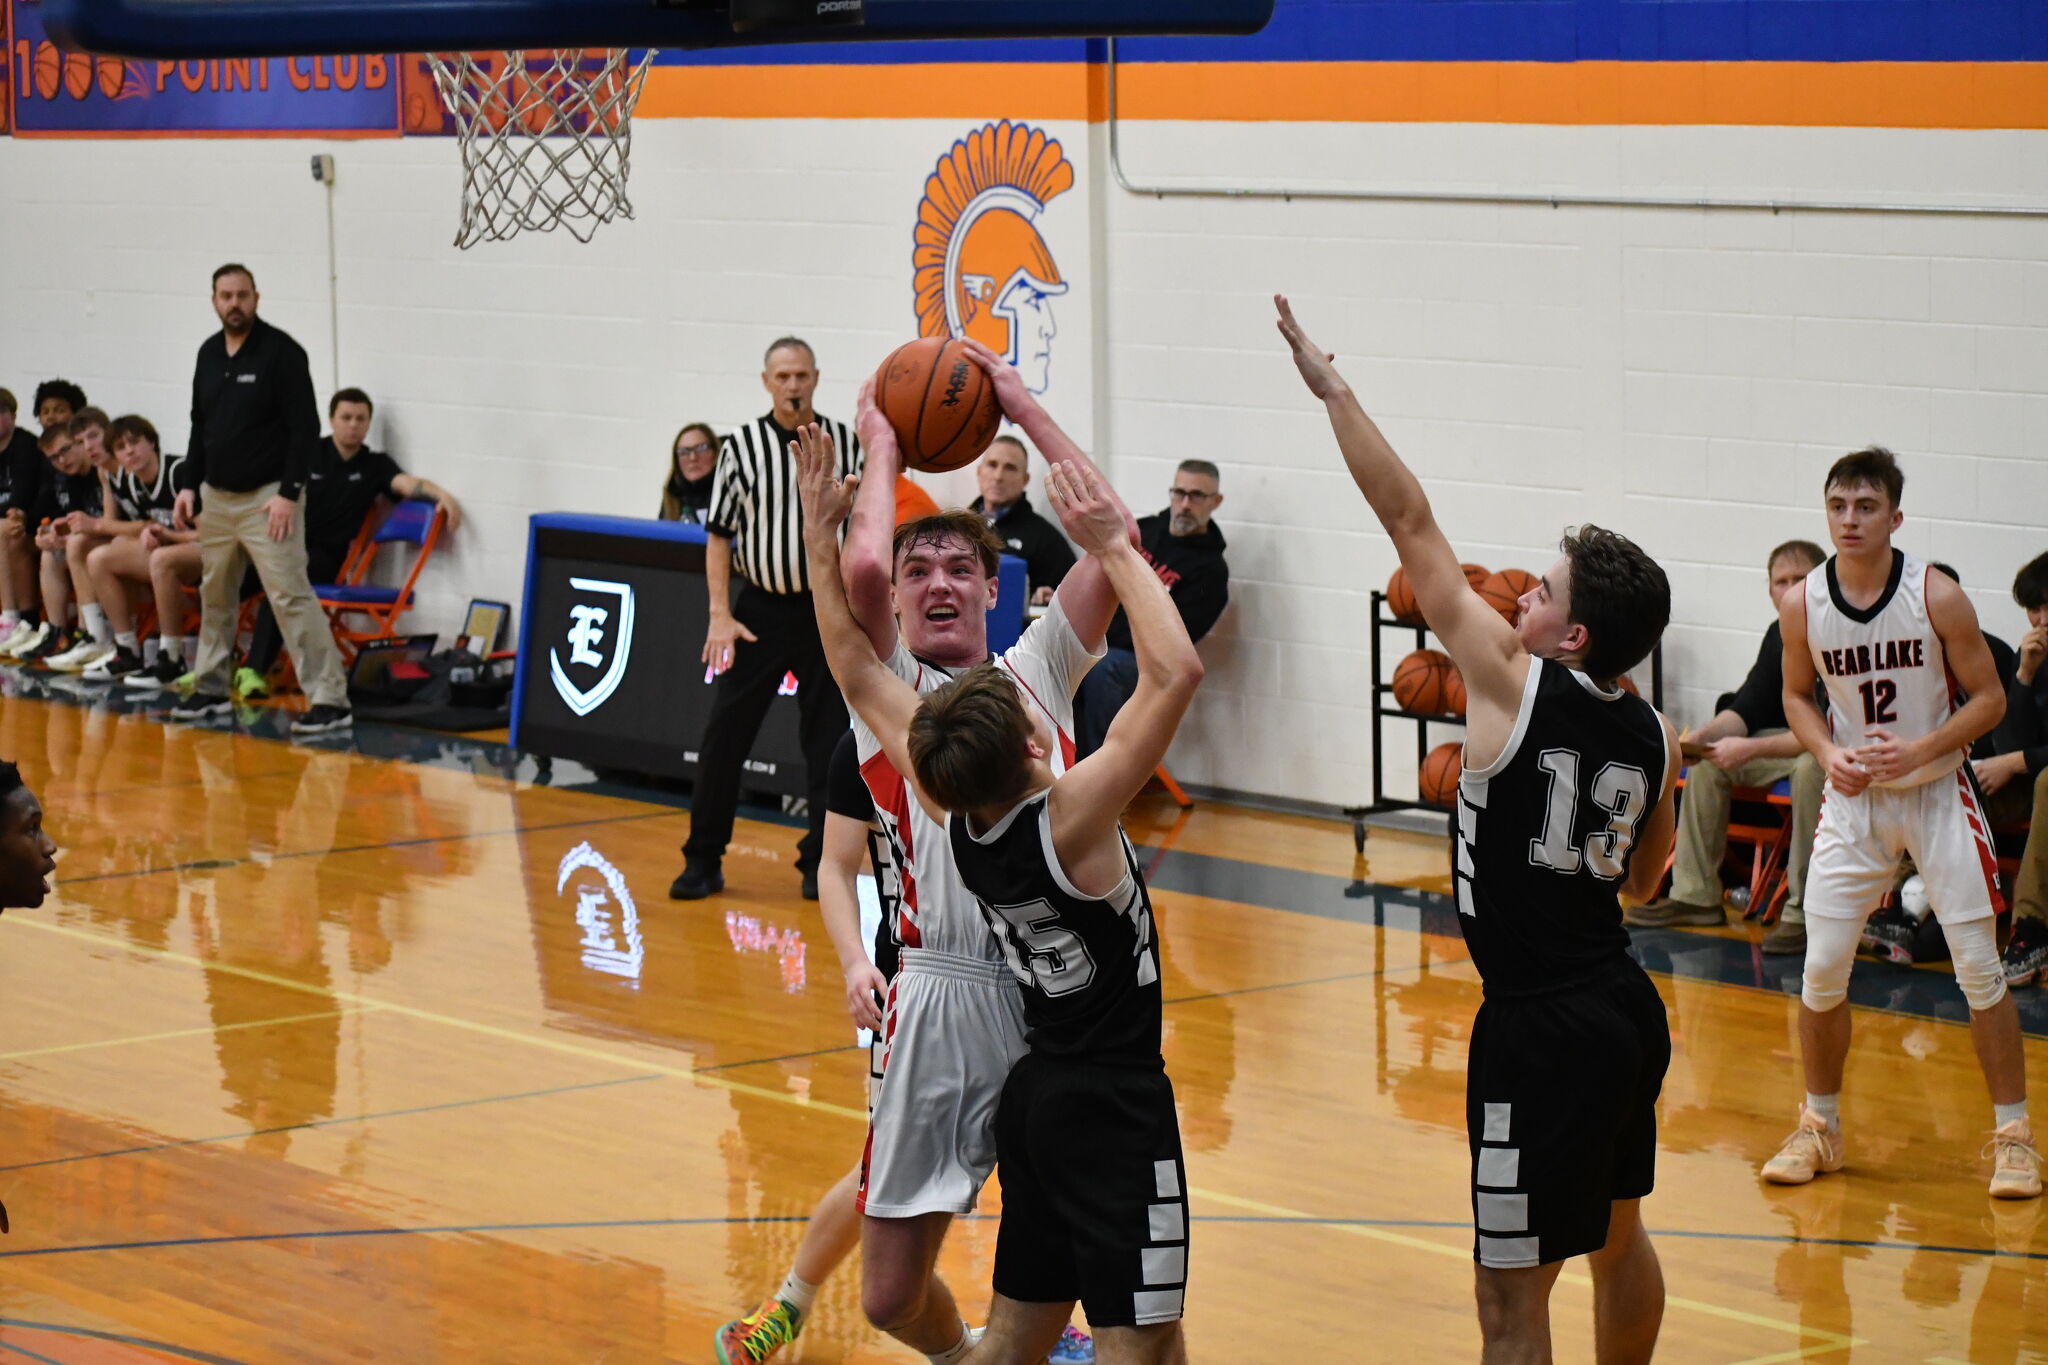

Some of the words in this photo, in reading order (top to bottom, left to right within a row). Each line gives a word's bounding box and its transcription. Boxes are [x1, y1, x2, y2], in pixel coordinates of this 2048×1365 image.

[286, 53, 388, 91] CLUB
[568, 604, 609, 668] E
[1821, 645, 1871, 676] BEAR
[1874, 639, 1924, 671] LAKE
[1858, 678, 1898, 726] 12
[1528, 747, 1649, 881] 13
[975, 897, 1097, 998] 15
